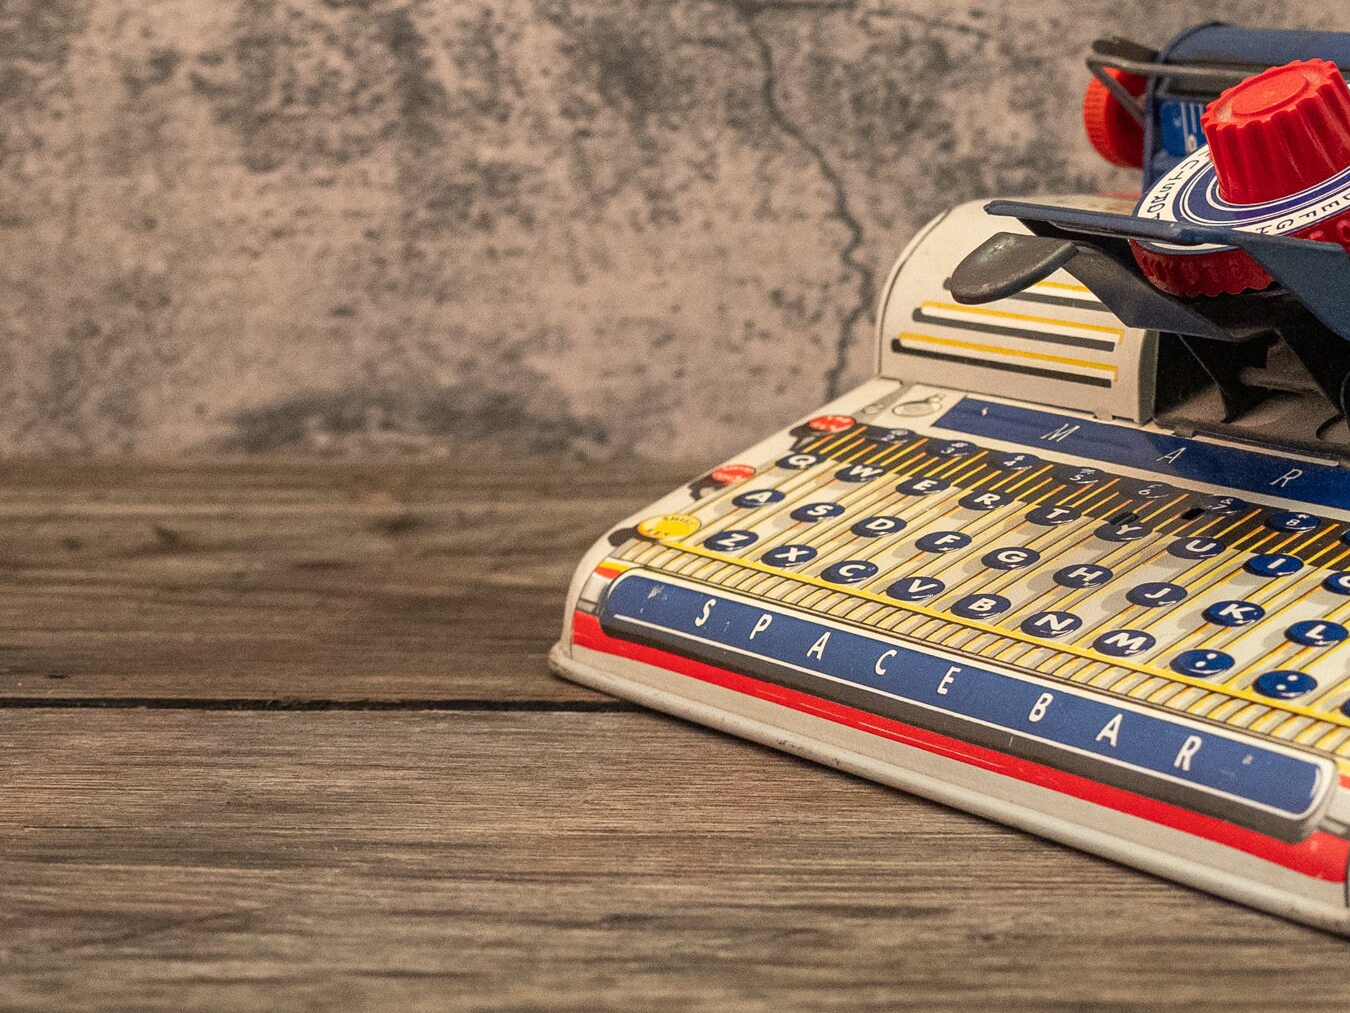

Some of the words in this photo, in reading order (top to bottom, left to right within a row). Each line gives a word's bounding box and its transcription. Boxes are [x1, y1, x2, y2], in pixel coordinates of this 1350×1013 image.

[744, 490, 774, 503] A
[806, 504, 835, 517] S
[871, 518, 897, 531] D
[933, 534, 961, 547] F
[996, 550, 1029, 563] G
[1067, 567, 1104, 582] H
[1143, 587, 1173, 599] J
[1218, 603, 1255, 620] K
[1304, 624, 1327, 639] L
[788, 453, 817, 468] Q
[848, 464, 885, 478] W
[919, 478, 939, 491] E
[973, 493, 1001, 506] R
[1045, 507, 1070, 520] T
[1115, 524, 1144, 535] Y
[1184, 539, 1217, 553] U
[714, 533, 744, 547] Z
[773, 547, 804, 562] X
[838, 564, 868, 578] C
[906, 578, 939, 596] V
[966, 598, 997, 613] B
[1033, 613, 1075, 630] N
[1103, 632, 1148, 651] M
[694, 598, 963, 695] SPACE
[1028, 692, 1203, 772] BAR
